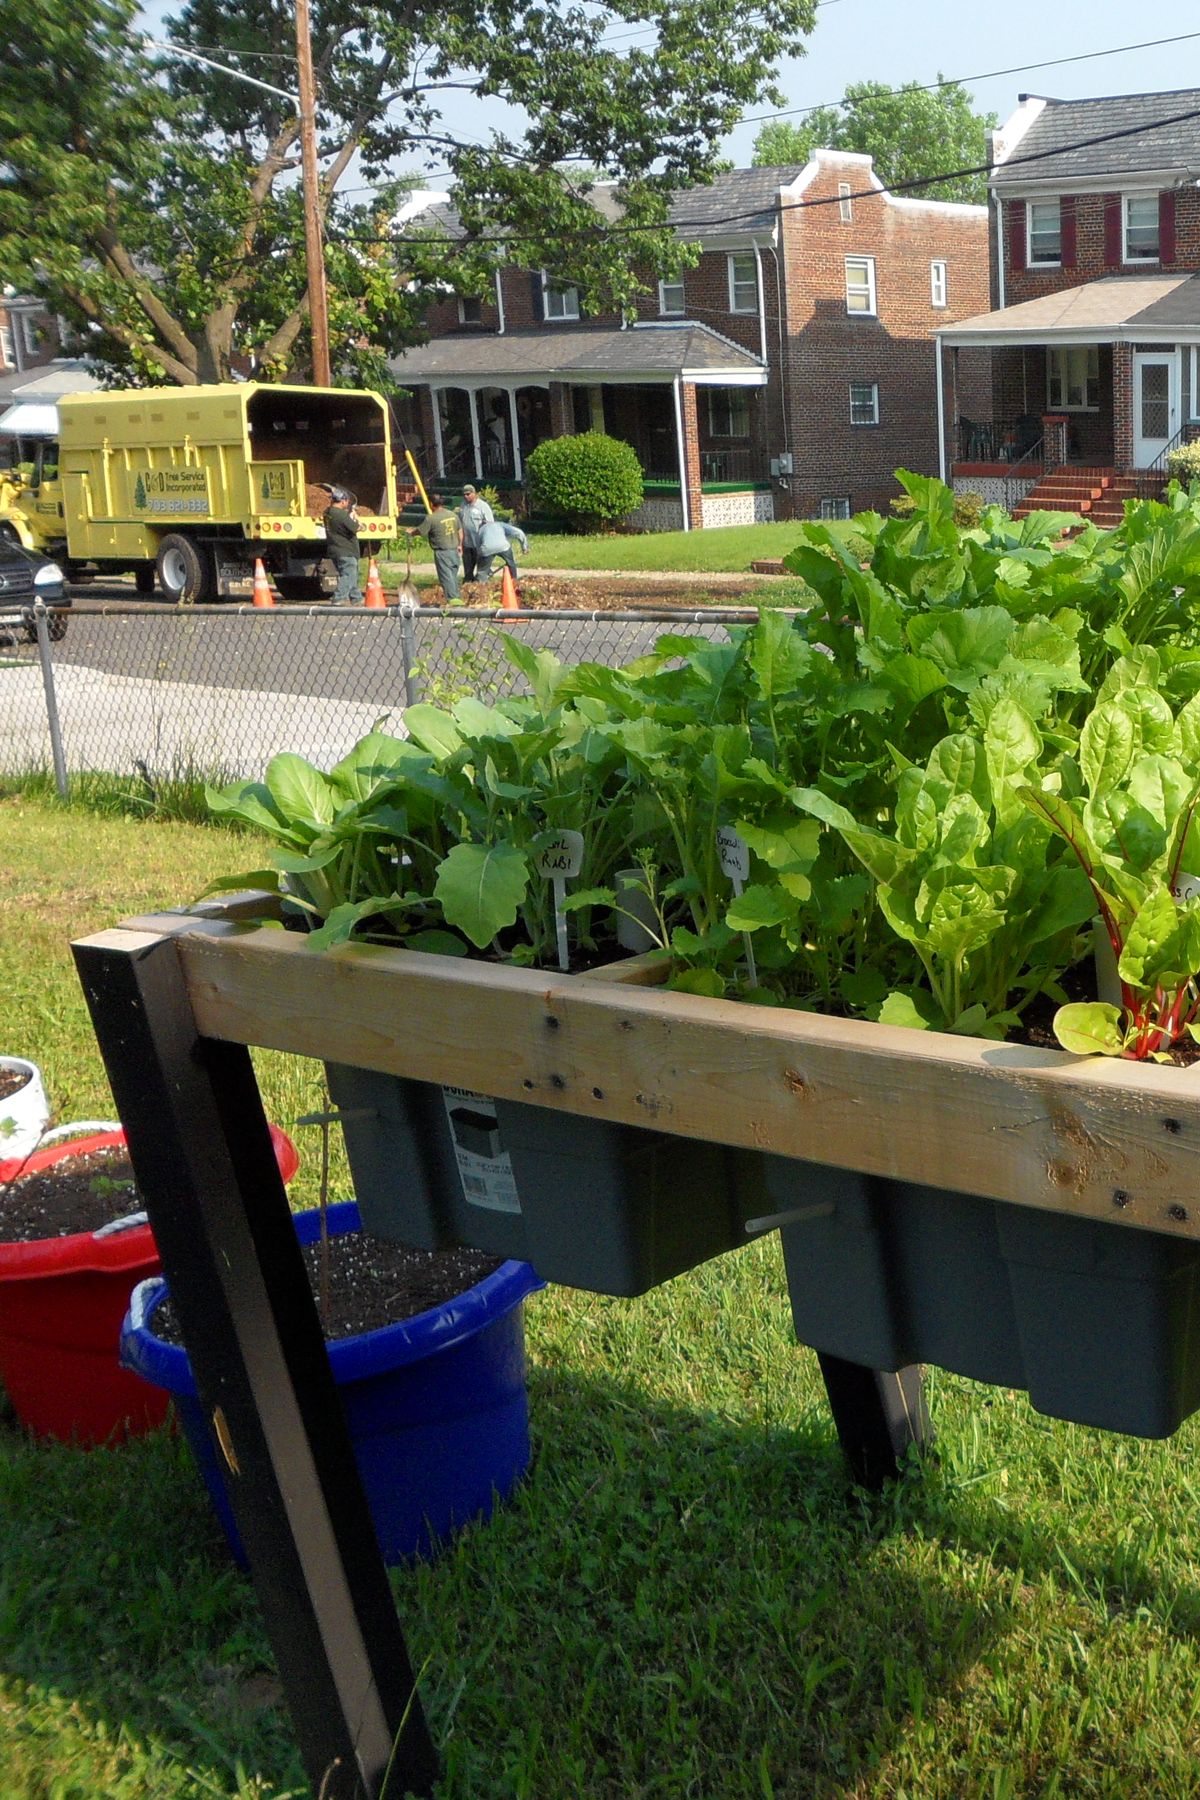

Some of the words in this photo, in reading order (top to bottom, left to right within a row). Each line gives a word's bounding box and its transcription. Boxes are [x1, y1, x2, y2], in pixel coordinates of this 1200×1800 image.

[165, 472, 179, 481] Tree
[181, 472, 205, 481] Service
[166, 483, 207, 493] Incorporated
